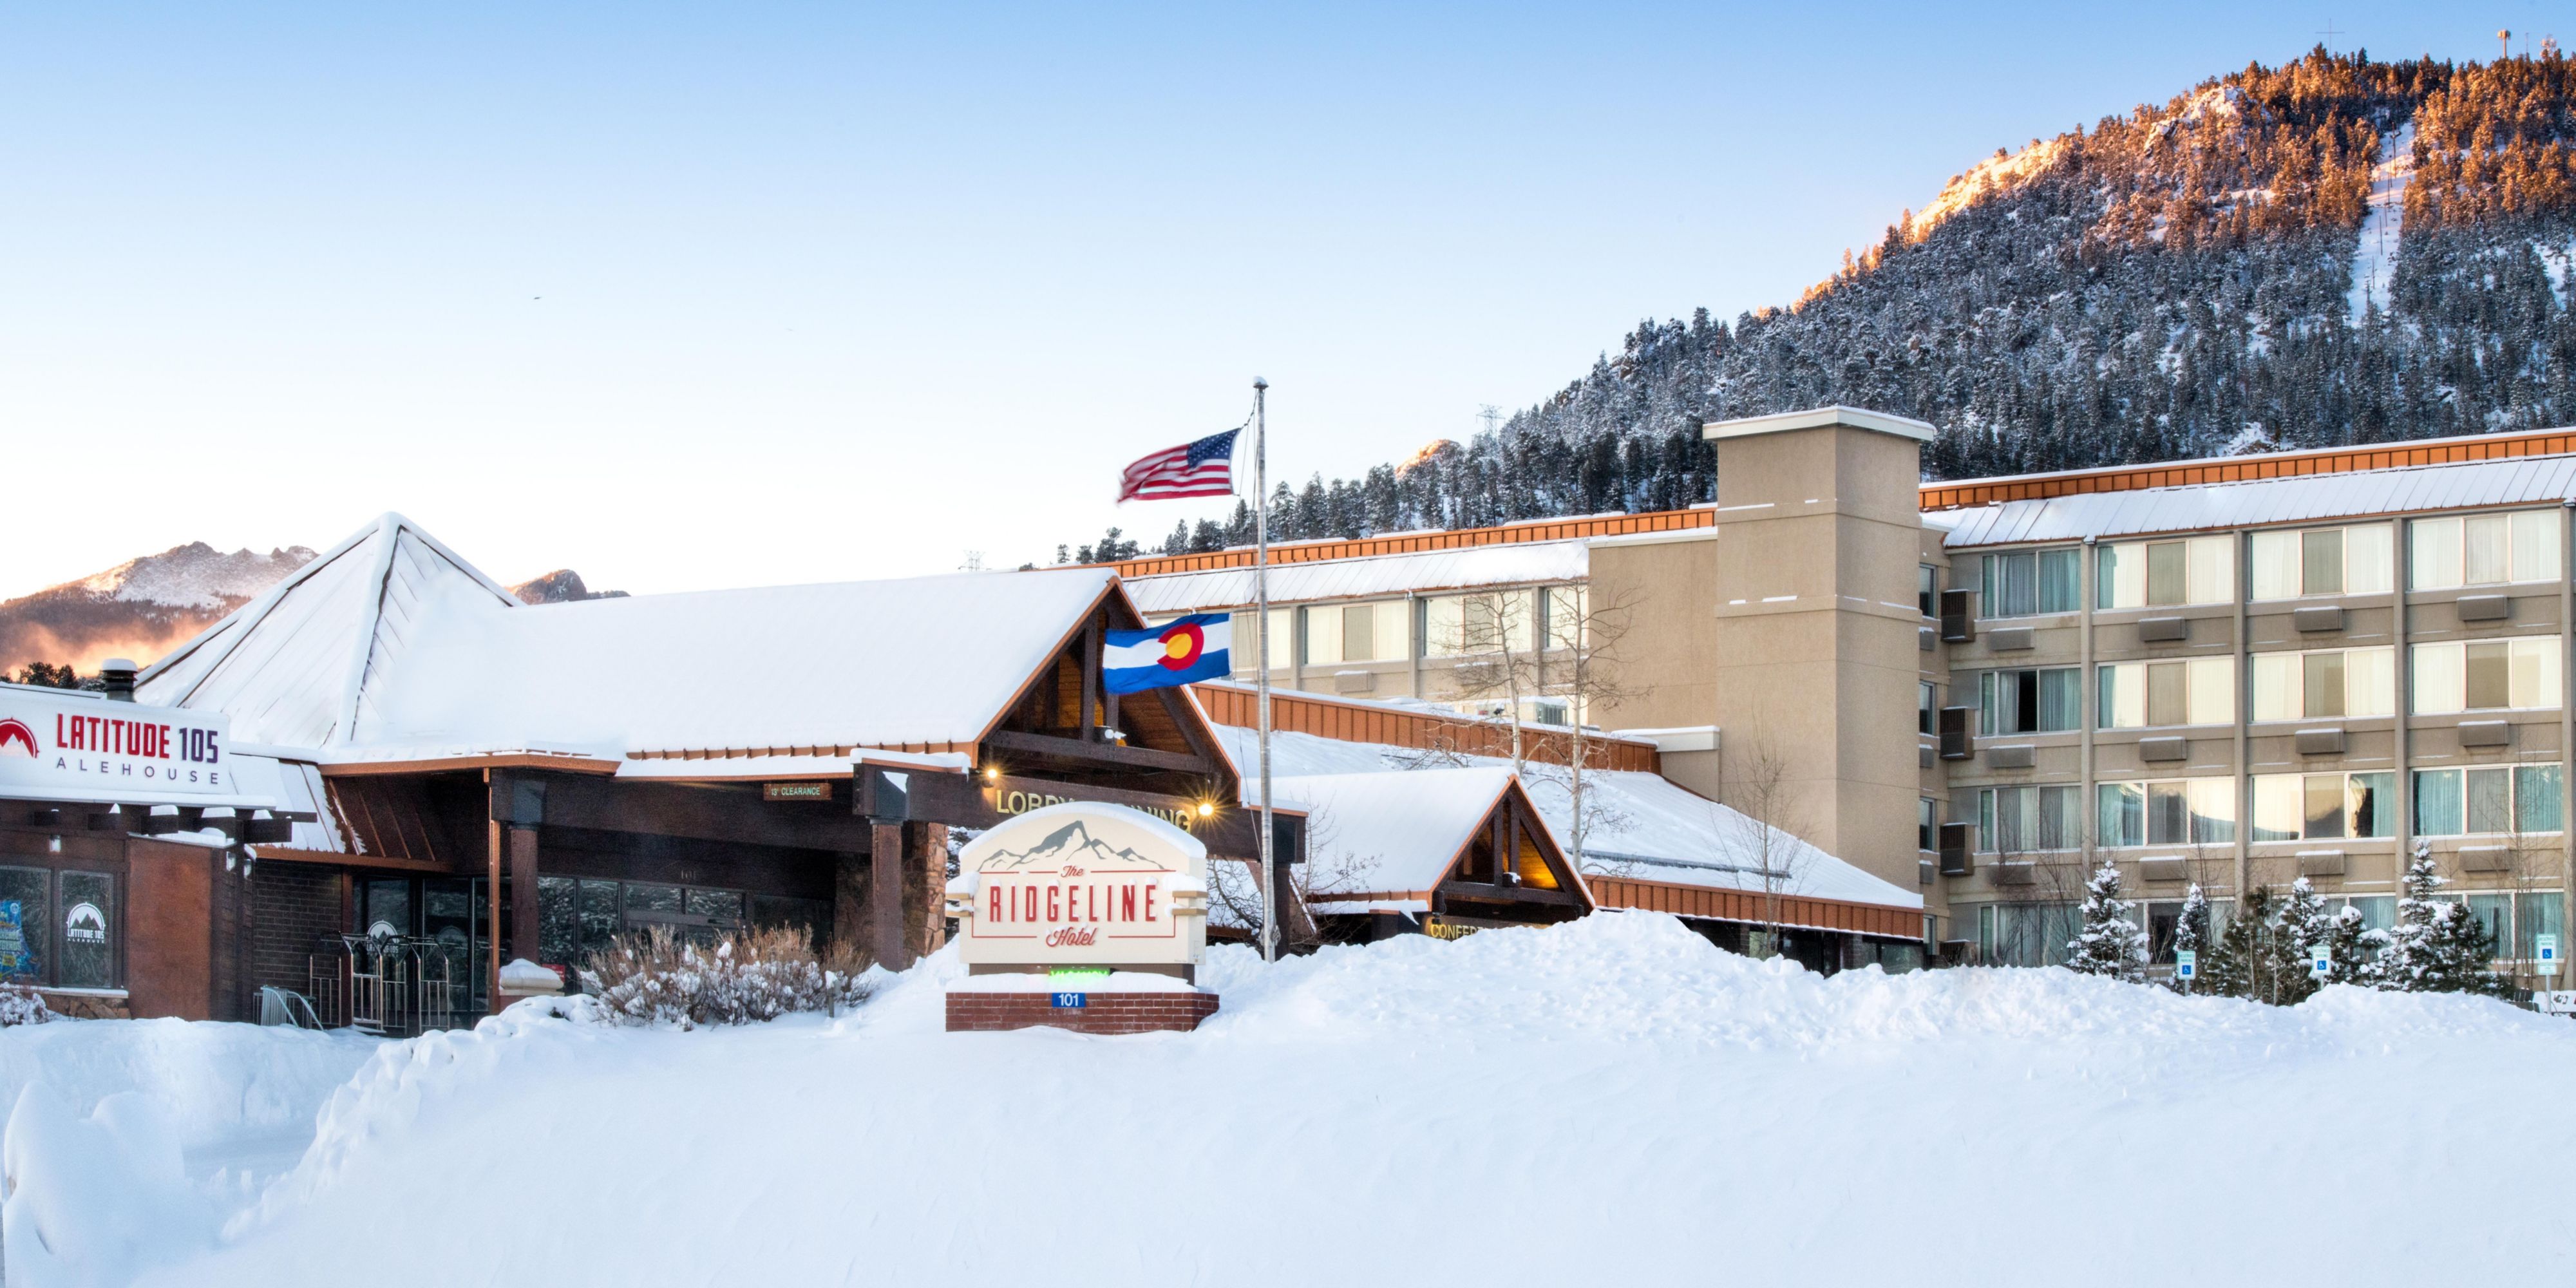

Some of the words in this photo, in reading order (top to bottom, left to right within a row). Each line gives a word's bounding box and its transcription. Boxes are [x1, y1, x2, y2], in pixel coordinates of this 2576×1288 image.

[57, 713, 171, 759] LATITUDE
[179, 727, 218, 763] 105
[56, 757, 219, 784] ALEHOUSE
[781, 787, 820, 796] CLEARANCE
[996, 790, 1074, 815] LOB
[1061, 865, 1084, 878] The
[990, 885, 1157, 922] RIDGELINE
[67, 928, 93, 938] LATITUDE
[94, 930, 104, 939] 105
[1045, 926, 1097, 947] Hotel
[1059, 993, 1079, 1007] 101
